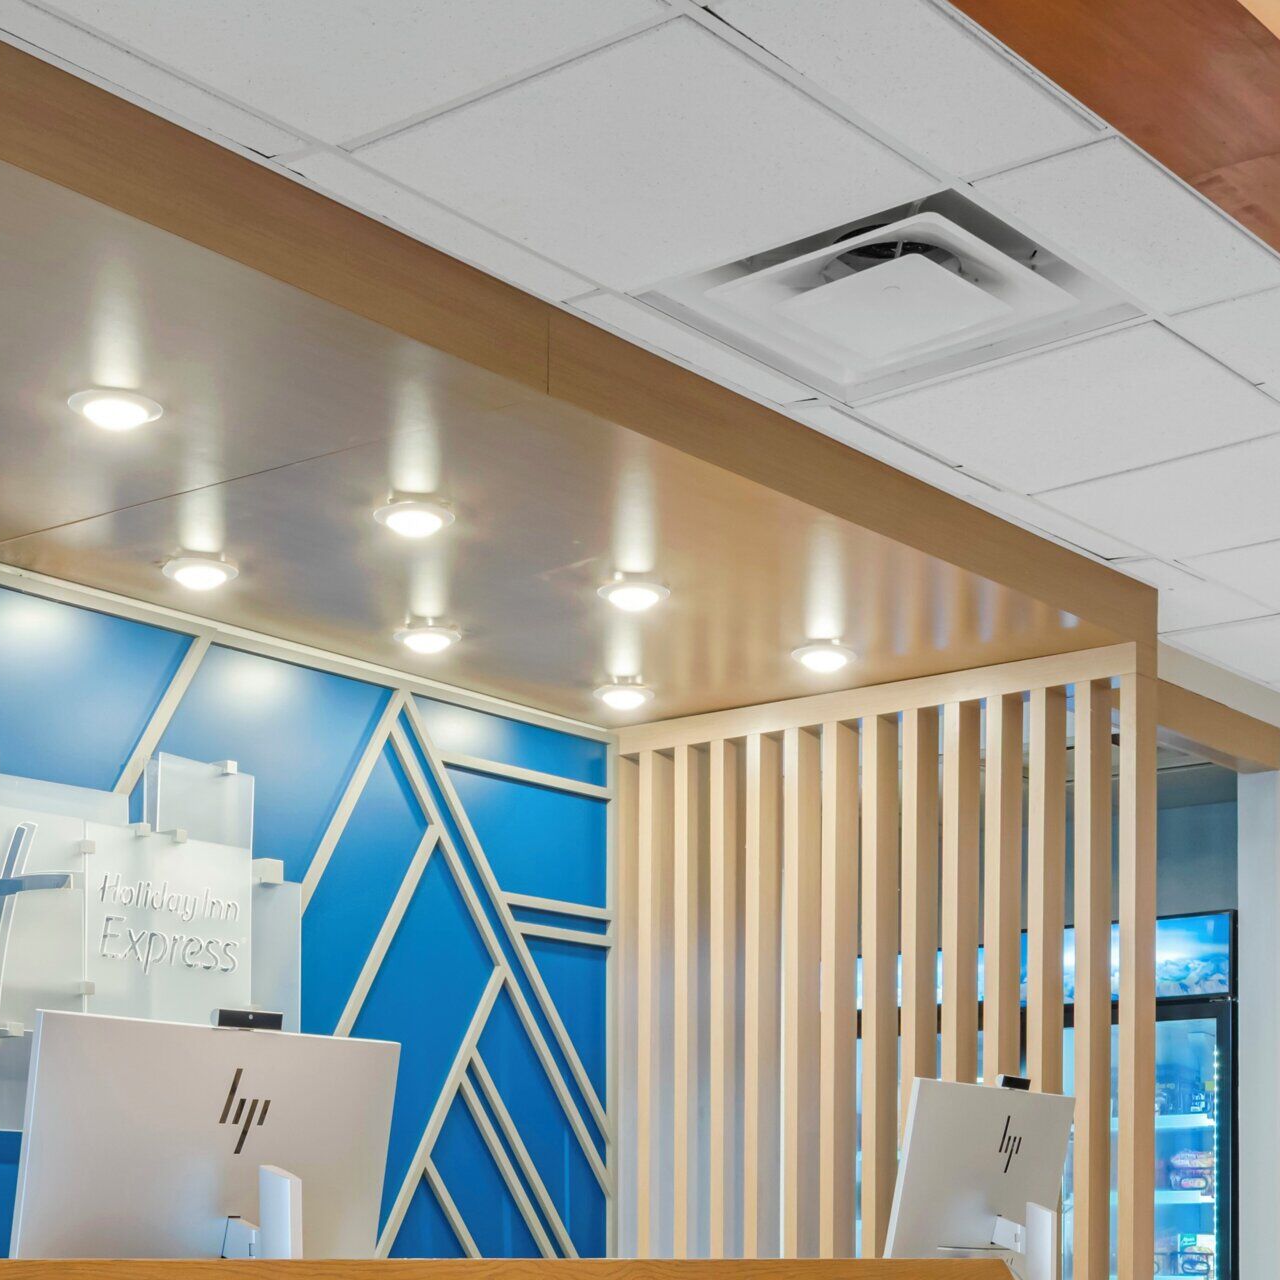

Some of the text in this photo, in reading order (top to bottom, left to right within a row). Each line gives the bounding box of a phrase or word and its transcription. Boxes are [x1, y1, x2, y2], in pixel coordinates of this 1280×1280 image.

[99, 873, 240, 922] Holiday Inn
[99, 915, 240, 975] Express
[219, 1068, 271, 1154] hp
[999, 1115, 1022, 1173] hp
